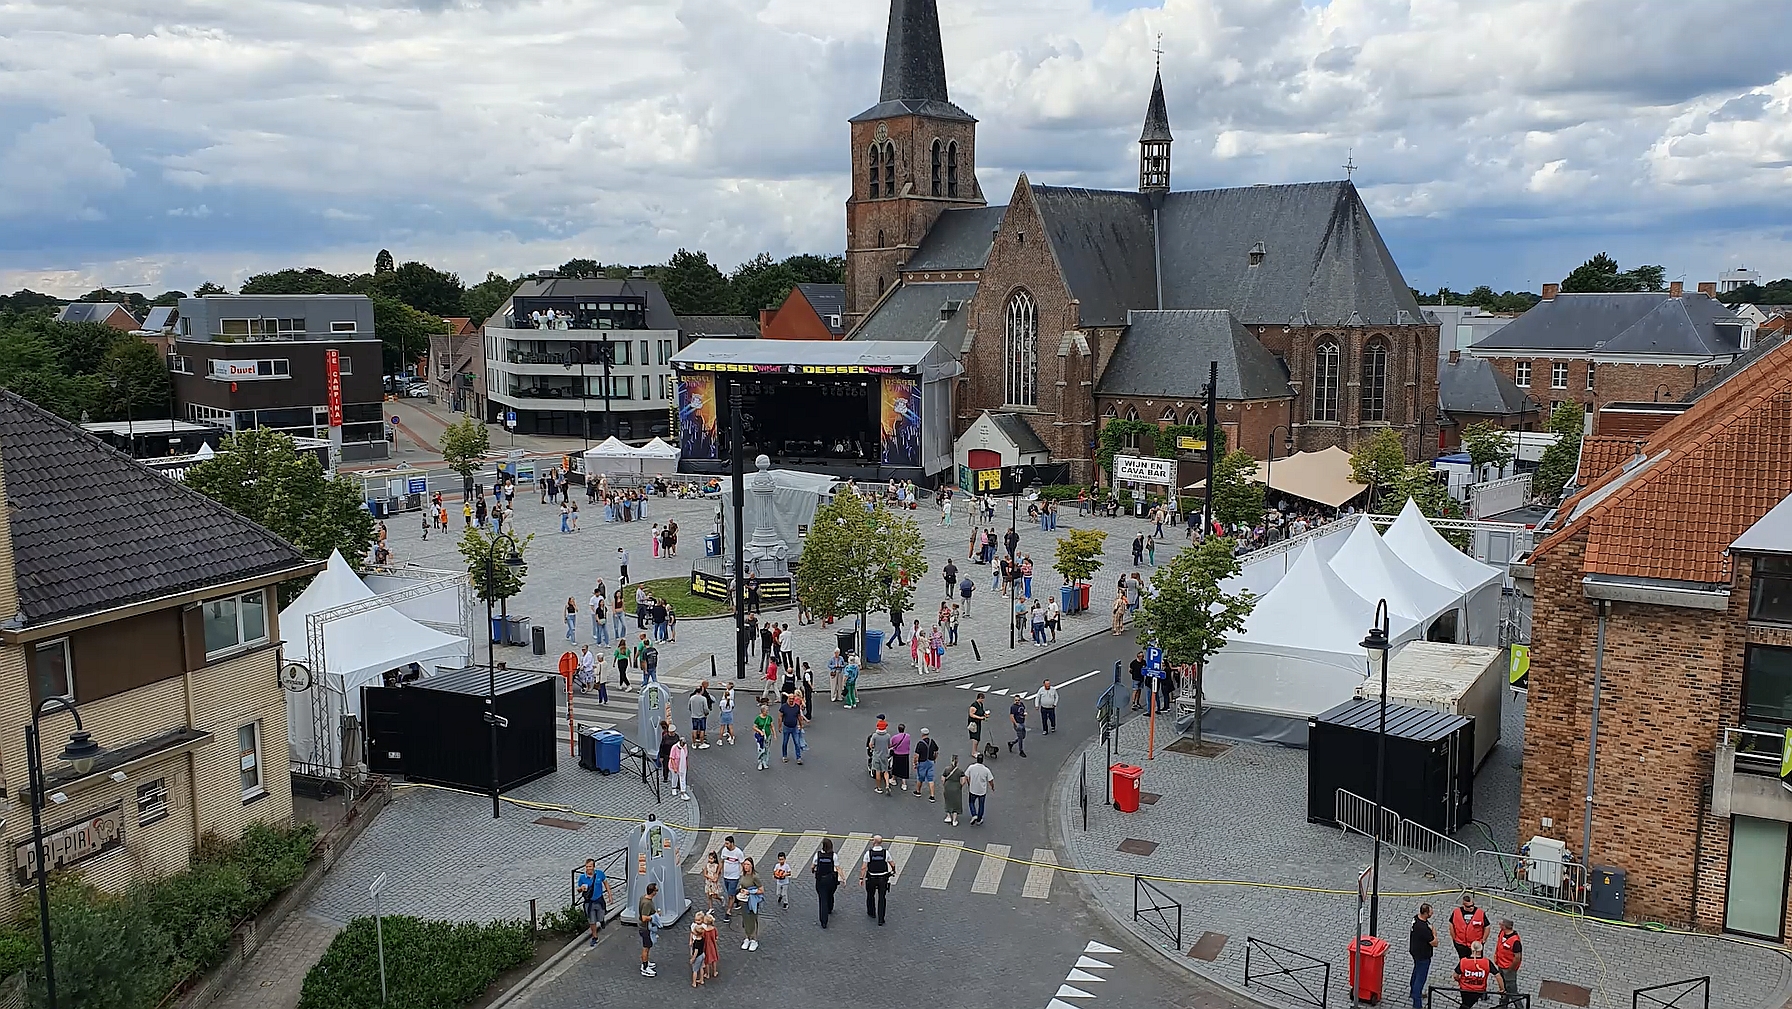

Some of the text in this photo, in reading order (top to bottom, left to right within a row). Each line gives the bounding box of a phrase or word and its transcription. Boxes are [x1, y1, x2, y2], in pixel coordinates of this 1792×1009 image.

[332, 351, 336, 364] DE
[230, 364, 256, 374] Duvel
[694, 362, 758, 372] DESSEL
[802, 365, 868, 374] DESSEL
[332, 372, 340, 418] CAMPINA
[1124, 460, 1148, 468] WIJN
[1121, 466, 1144, 474] CAVA
[1148, 470, 1166, 478] BAR
[1150, 649, 1158, 660] P
[27, 828, 90, 870] PRI-PIRI
